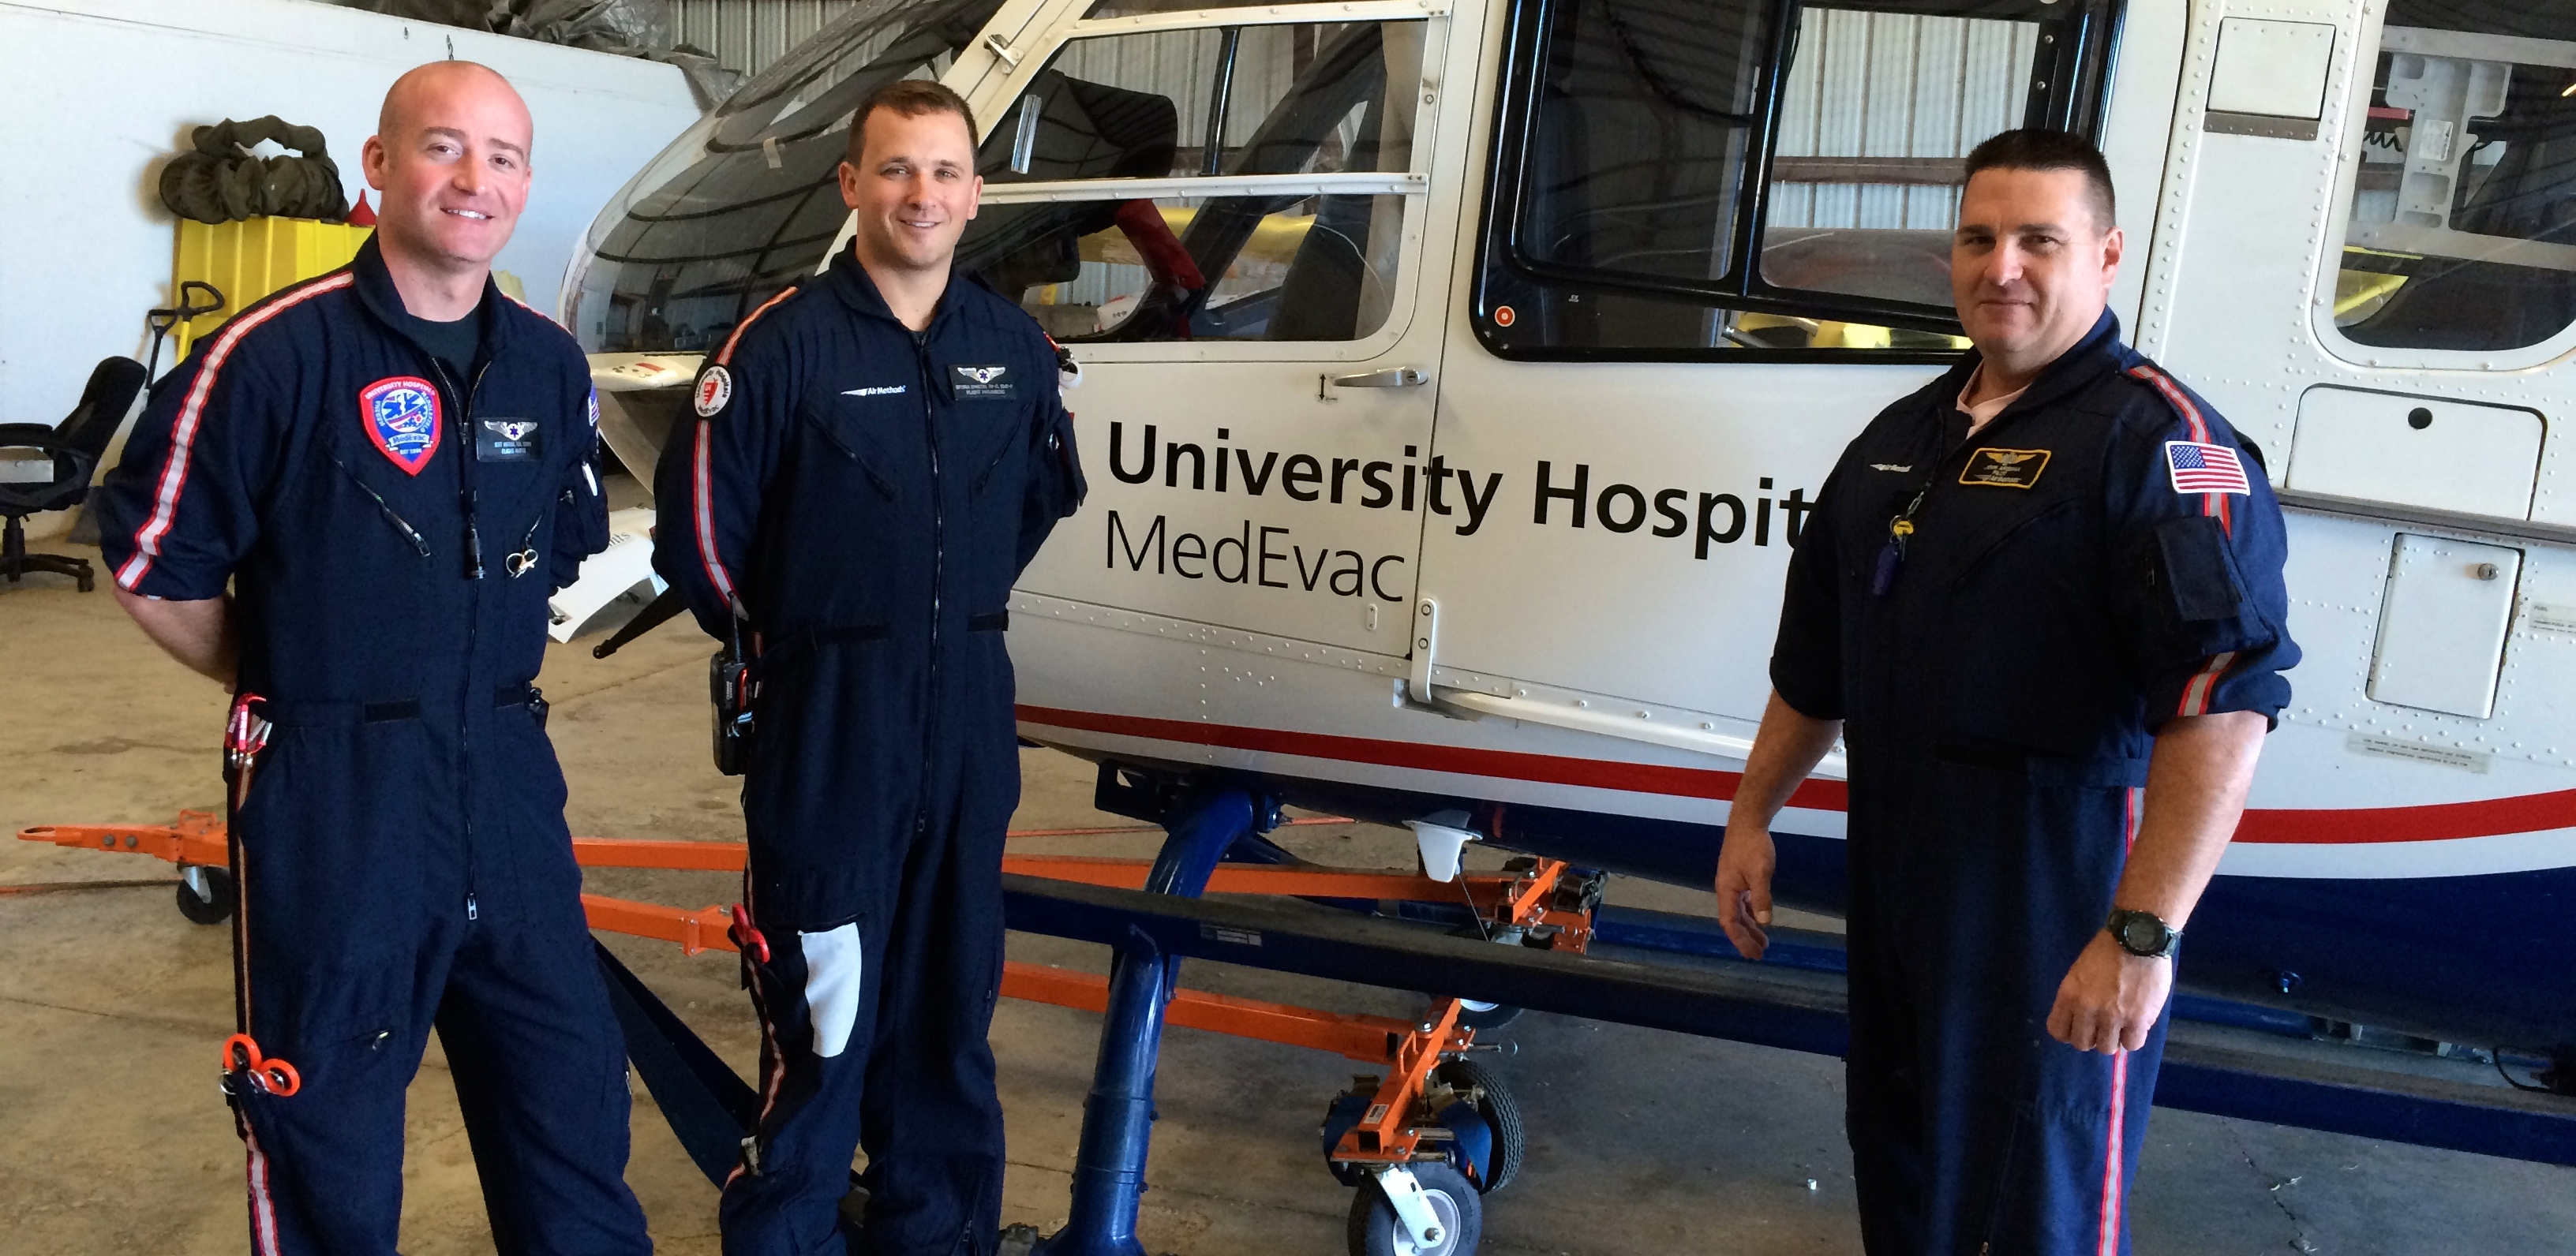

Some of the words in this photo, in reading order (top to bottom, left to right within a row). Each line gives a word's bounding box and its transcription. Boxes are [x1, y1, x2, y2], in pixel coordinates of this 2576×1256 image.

[365, 381, 402, 400] UNIVERSITY
[867, 387, 877, 395] Air
[877, 385, 906, 394] Methods
[1108, 421, 1503, 536] University
[1533, 460, 1816, 560] Hospit
[1106, 510, 1406, 602] MedEvac
